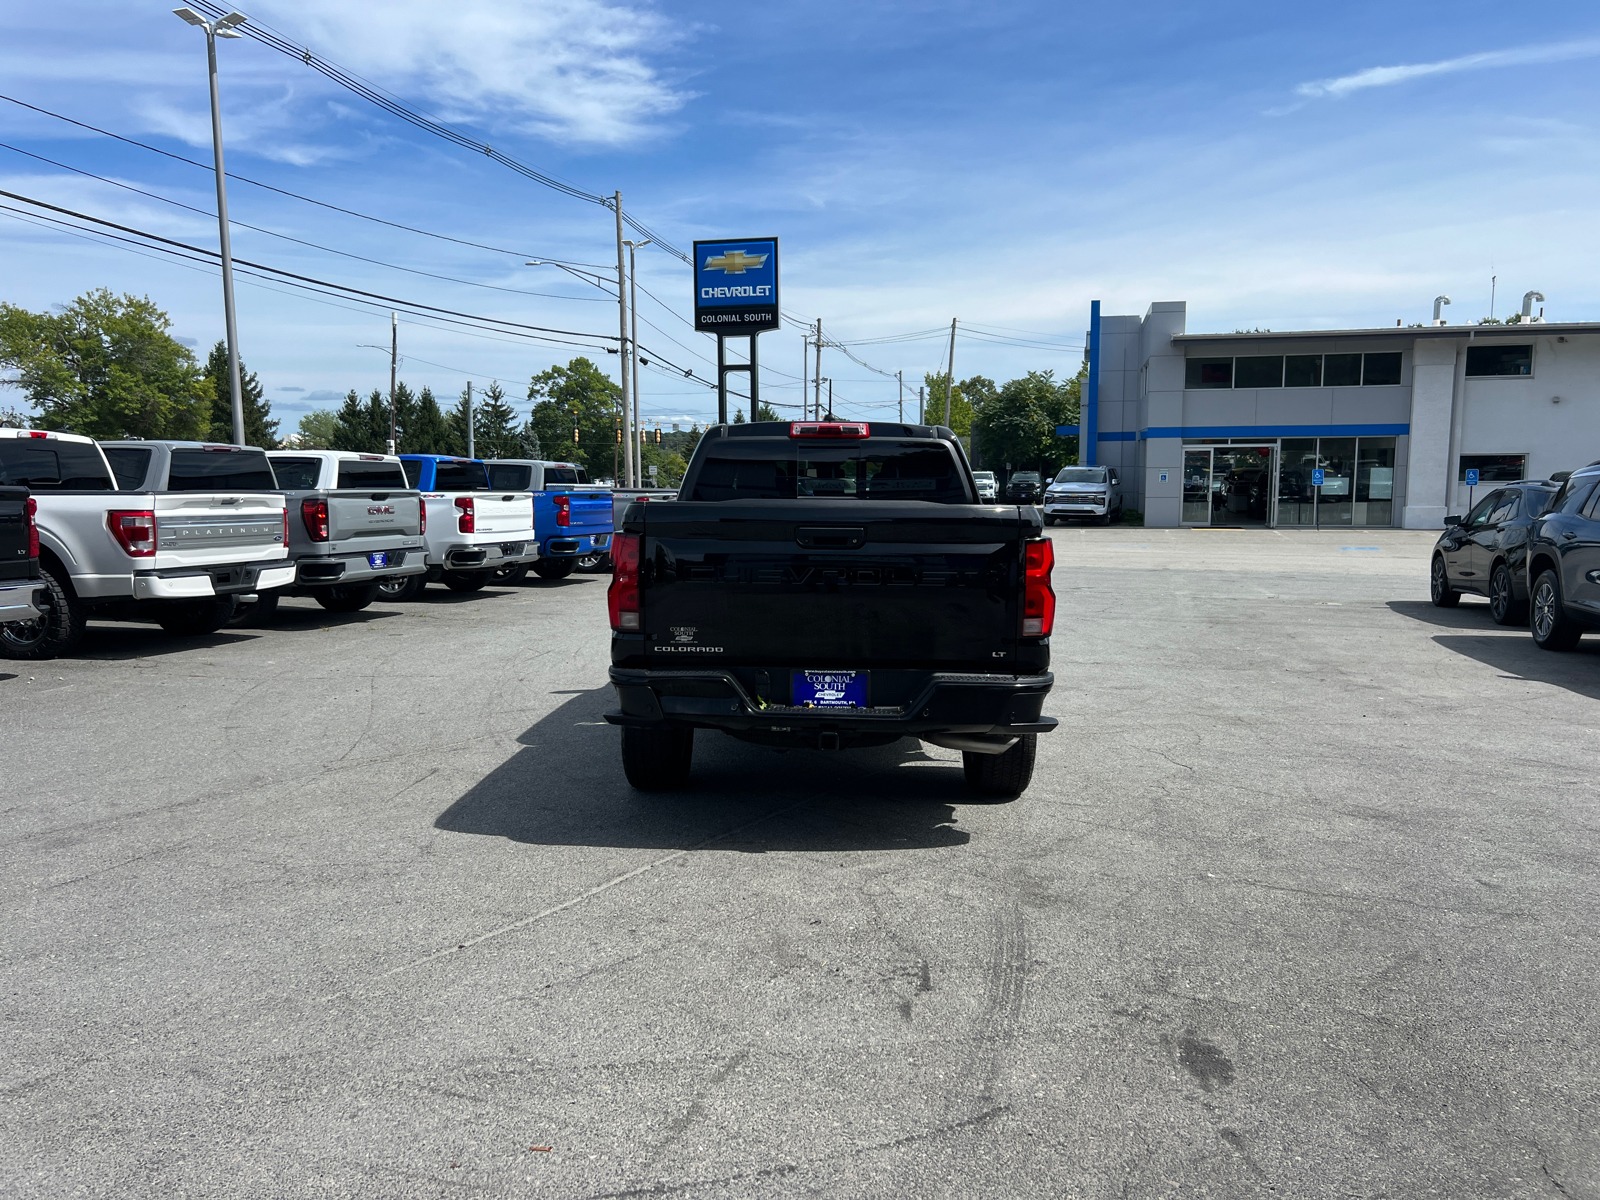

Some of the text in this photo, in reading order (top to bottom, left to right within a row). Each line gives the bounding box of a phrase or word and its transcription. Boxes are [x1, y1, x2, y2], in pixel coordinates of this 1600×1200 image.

[701, 285, 772, 298] CHEVROLET
[701, 313, 772, 323] COLONIAL SOUTH
[367, 505, 396, 515] GMC
[182, 526, 270, 536] PLATINUM
[683, 565, 979, 587] CHEVROLET
[807, 675, 853, 683] COLONIAL
[814, 682, 846, 690] SOUTH
